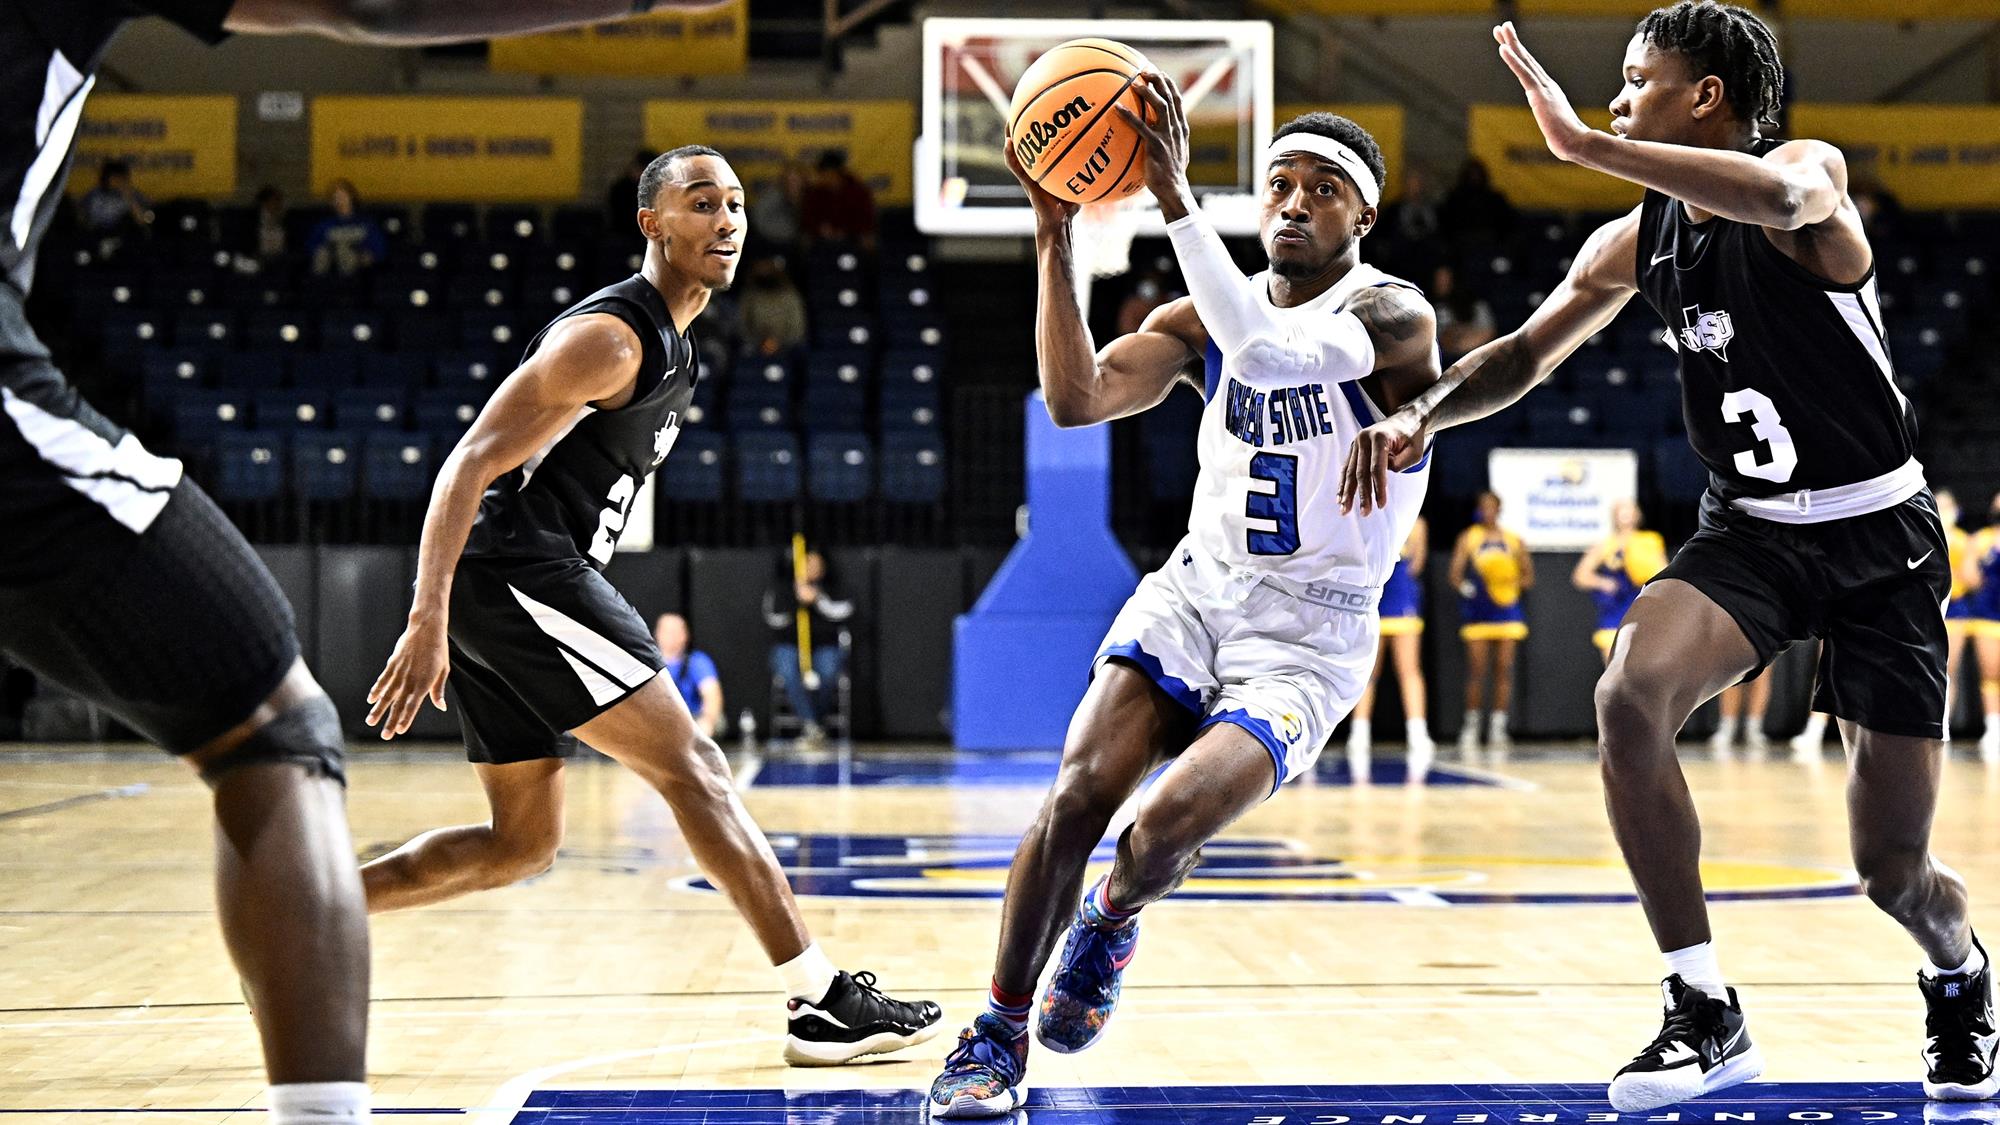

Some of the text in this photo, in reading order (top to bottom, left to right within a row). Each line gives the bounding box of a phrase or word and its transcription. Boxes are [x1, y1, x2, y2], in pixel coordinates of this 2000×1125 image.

[1016, 95, 1092, 170] Wilson
[1682, 310, 1735, 352] MSU
[1268, 383, 1333, 445] STATE
[1720, 387, 1798, 484] 3
[1245, 450, 1301, 556] 3
[1247, 1111, 1899, 1125] CONFERENCE
